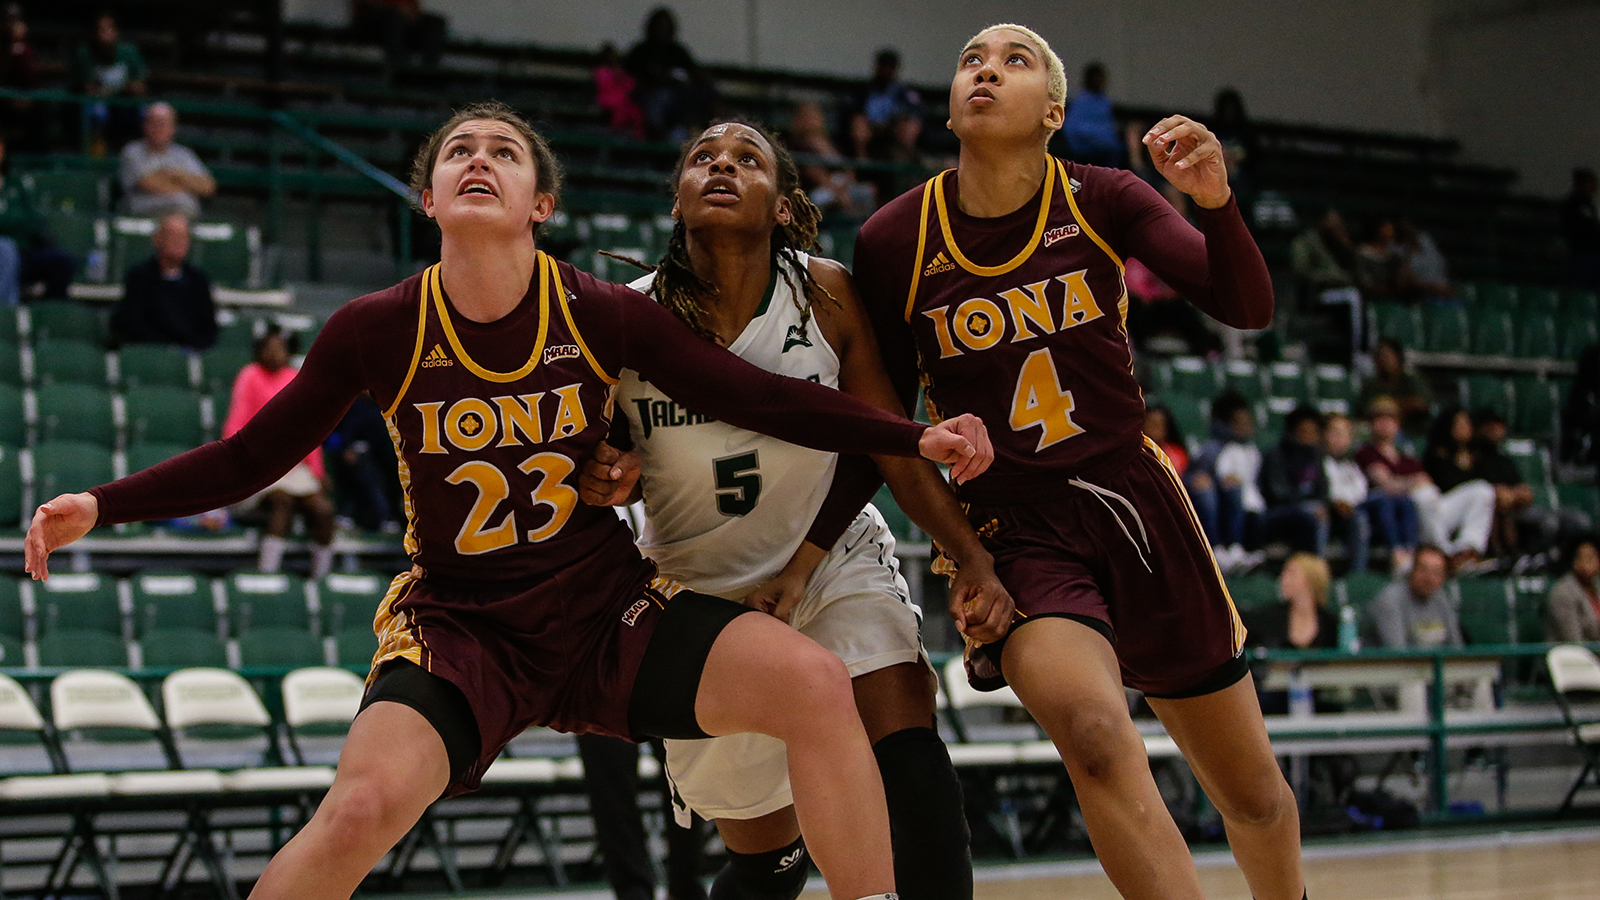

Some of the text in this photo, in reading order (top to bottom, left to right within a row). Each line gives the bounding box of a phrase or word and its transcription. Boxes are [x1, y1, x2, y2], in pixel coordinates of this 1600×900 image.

[1044, 224, 1080, 247] MAAC
[924, 262, 956, 277] adidas
[921, 268, 1105, 359] IONA
[421, 358, 454, 368] adidas
[543, 344, 580, 365] MAAC
[413, 382, 588, 454] IONA
[1009, 346, 1087, 453] 4
[444, 451, 579, 554] 23
[711, 448, 763, 518] 5
[621, 599, 650, 627] MAAC
